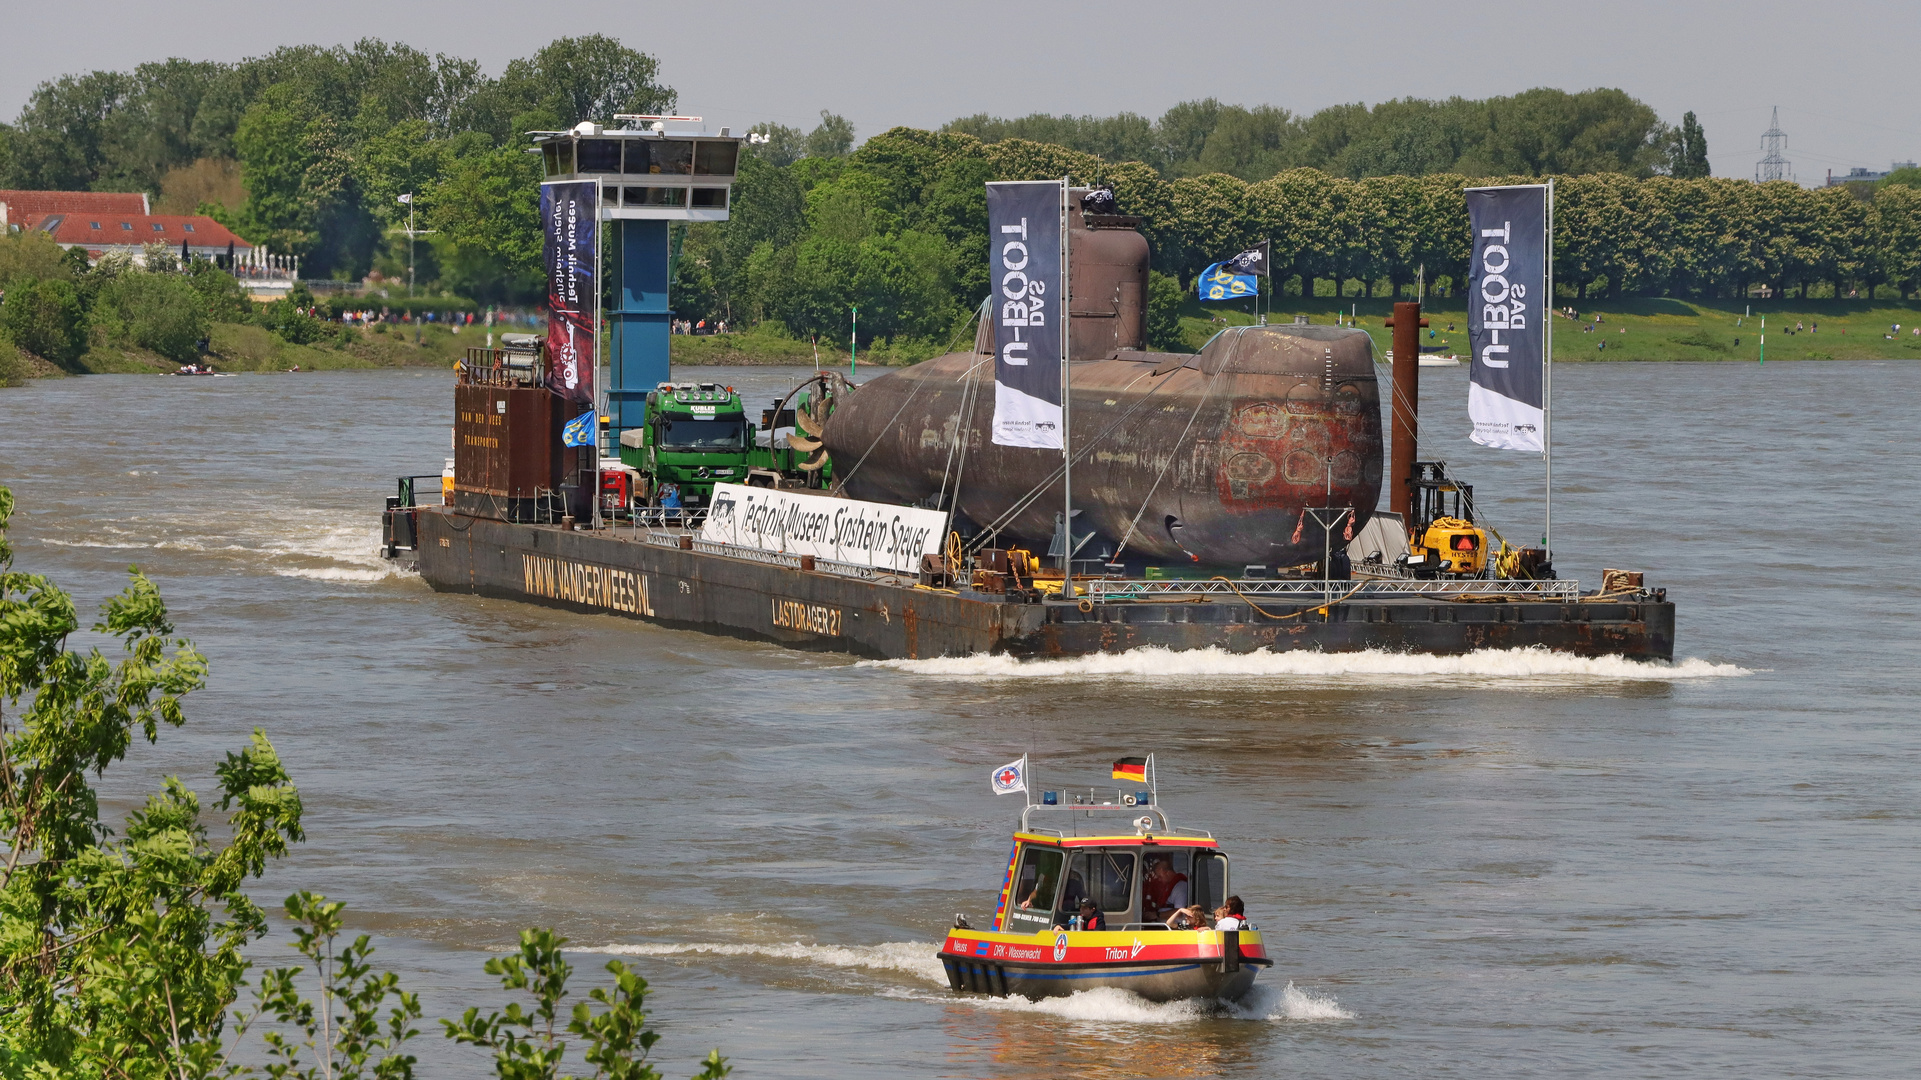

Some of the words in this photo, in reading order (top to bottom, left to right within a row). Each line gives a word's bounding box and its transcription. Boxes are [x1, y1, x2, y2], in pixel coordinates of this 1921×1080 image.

[461, 411, 472, 423] VAN
[475, 413, 485, 424] DER
[464, 434, 499, 449] TRANSPORTEN
[740, 495, 787, 537] Technik
[787, 502, 830, 544] Museen
[829, 507, 888, 552] Sinsheim
[887, 515, 931, 567] Speyer
[522, 554, 655, 617] WWW.VANDERWEES.NL
[771, 598, 829, 635] LASTDRAGER
[829, 608, 842, 637] 27
[952, 939, 968, 953] Neuss
[993, 944, 1005, 957] DRK
[1008, 945, 1042, 960] Wasserwacht
[1105, 947, 1128, 960] Triton
